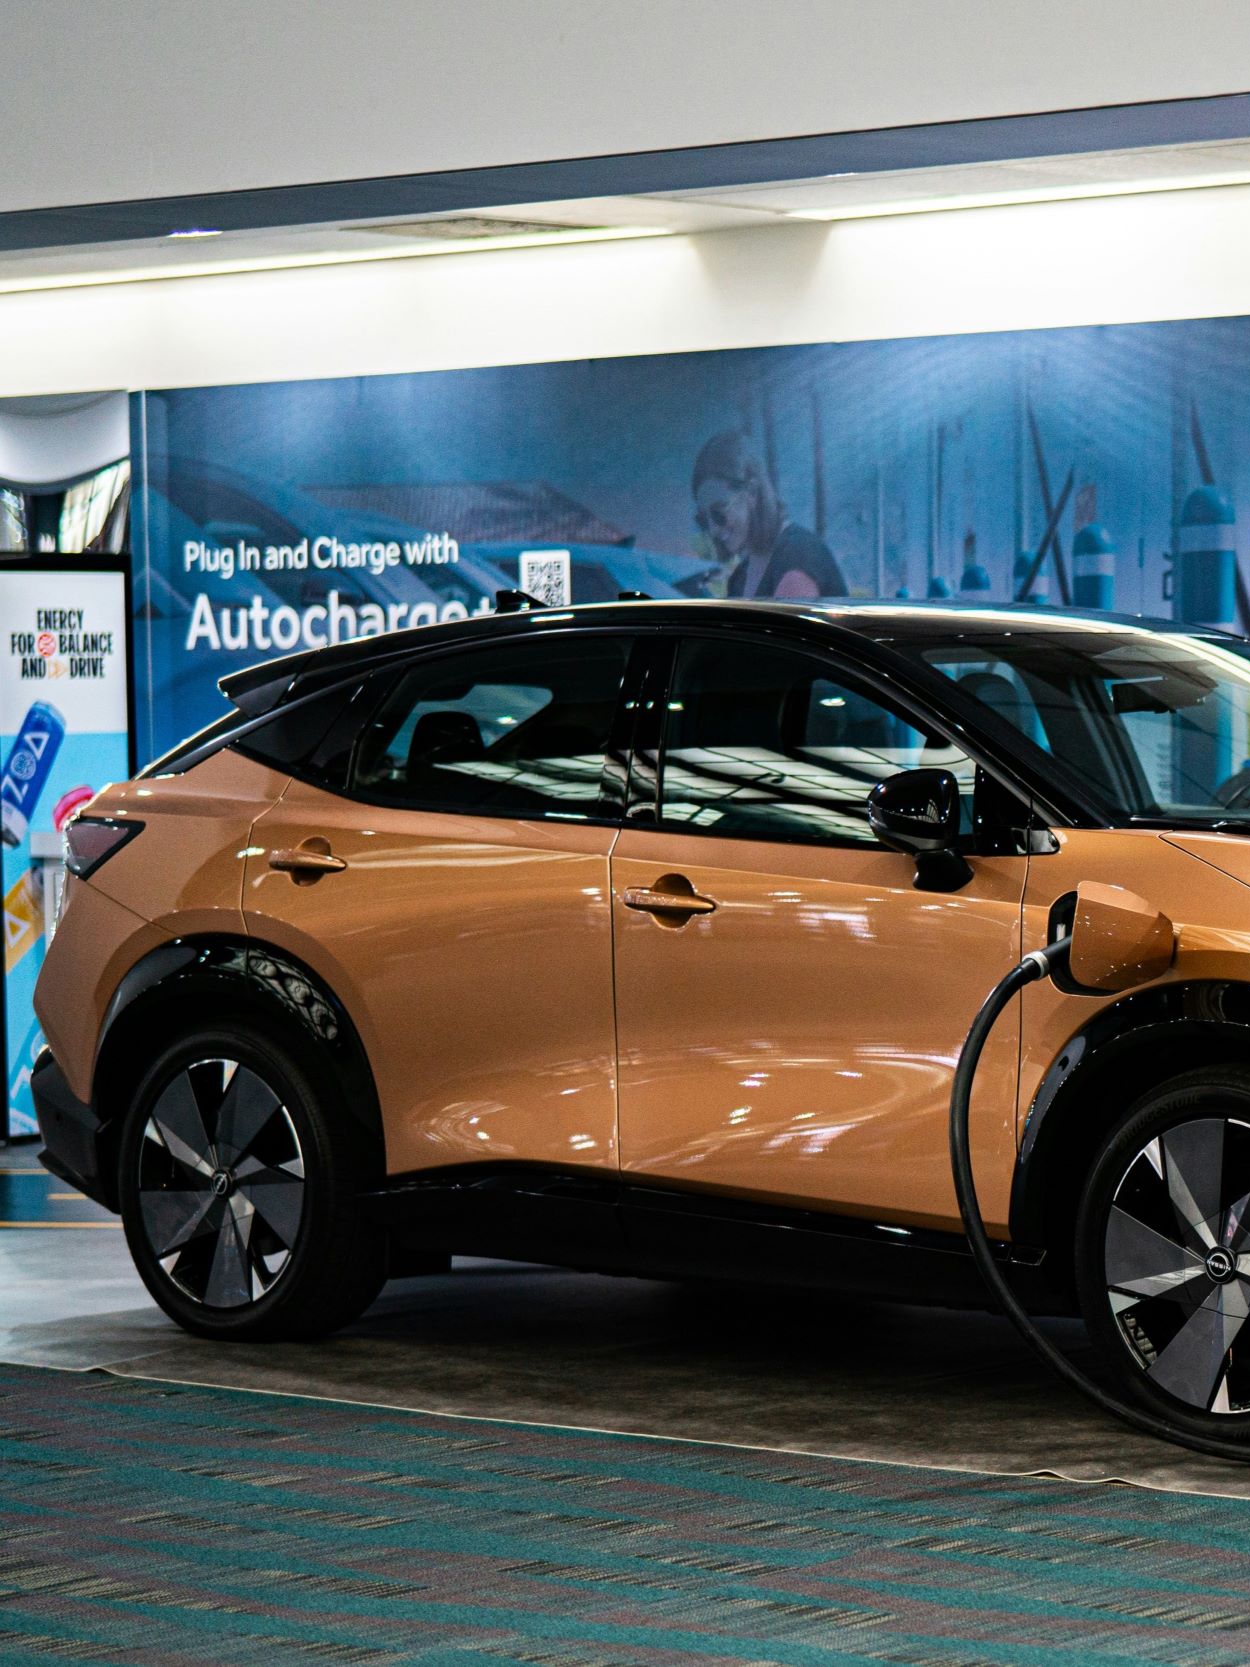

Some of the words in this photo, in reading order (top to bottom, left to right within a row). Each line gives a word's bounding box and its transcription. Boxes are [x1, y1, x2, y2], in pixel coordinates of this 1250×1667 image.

[184, 541, 235, 579] Plug
[238, 539, 261, 571] In
[264, 537, 309, 571] and
[312, 535, 401, 575] Charge
[403, 531, 459, 565] with
[37, 608, 84, 631] ENERGY
[11, 632, 35, 655] FOR
[58, 631, 114, 655] BALANCE
[21, 657, 46, 679] AND
[69, 656, 106, 679] DRIVE
